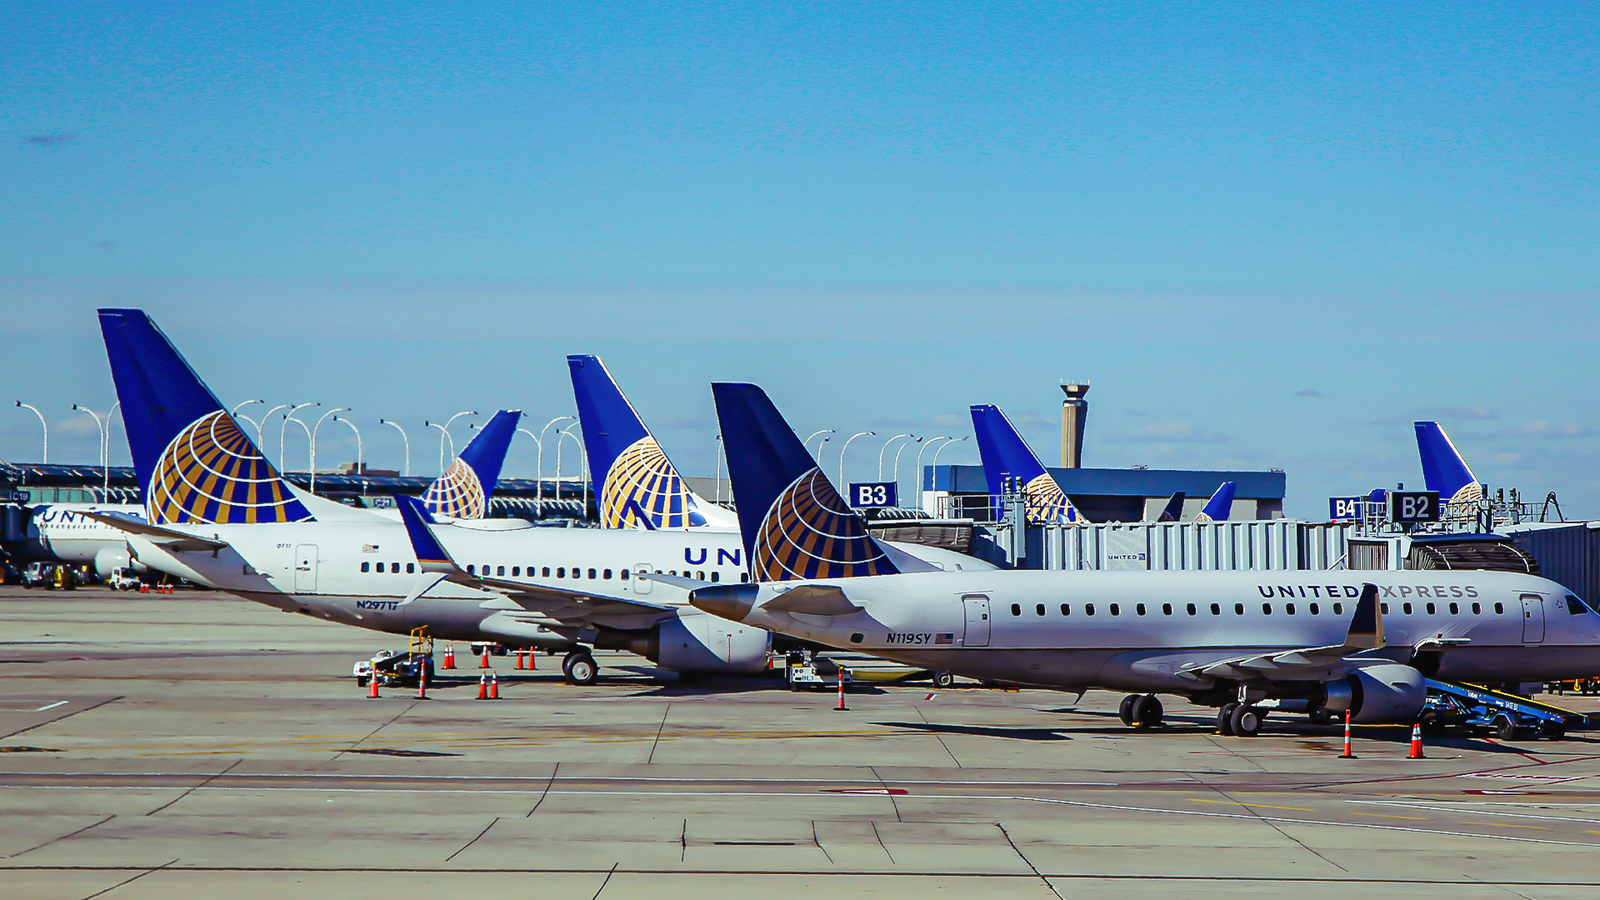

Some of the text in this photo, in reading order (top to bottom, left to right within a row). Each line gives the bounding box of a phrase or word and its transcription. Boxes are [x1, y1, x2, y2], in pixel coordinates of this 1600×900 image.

[859, 486, 887, 505] B3
[1336, 499, 1355, 517] B4
[1402, 496, 1429, 518] B2
[1257, 585, 1480, 598] UNITED XPRESS
[356, 600, 399, 611] N29717
[886, 632, 932, 645] N119SY
